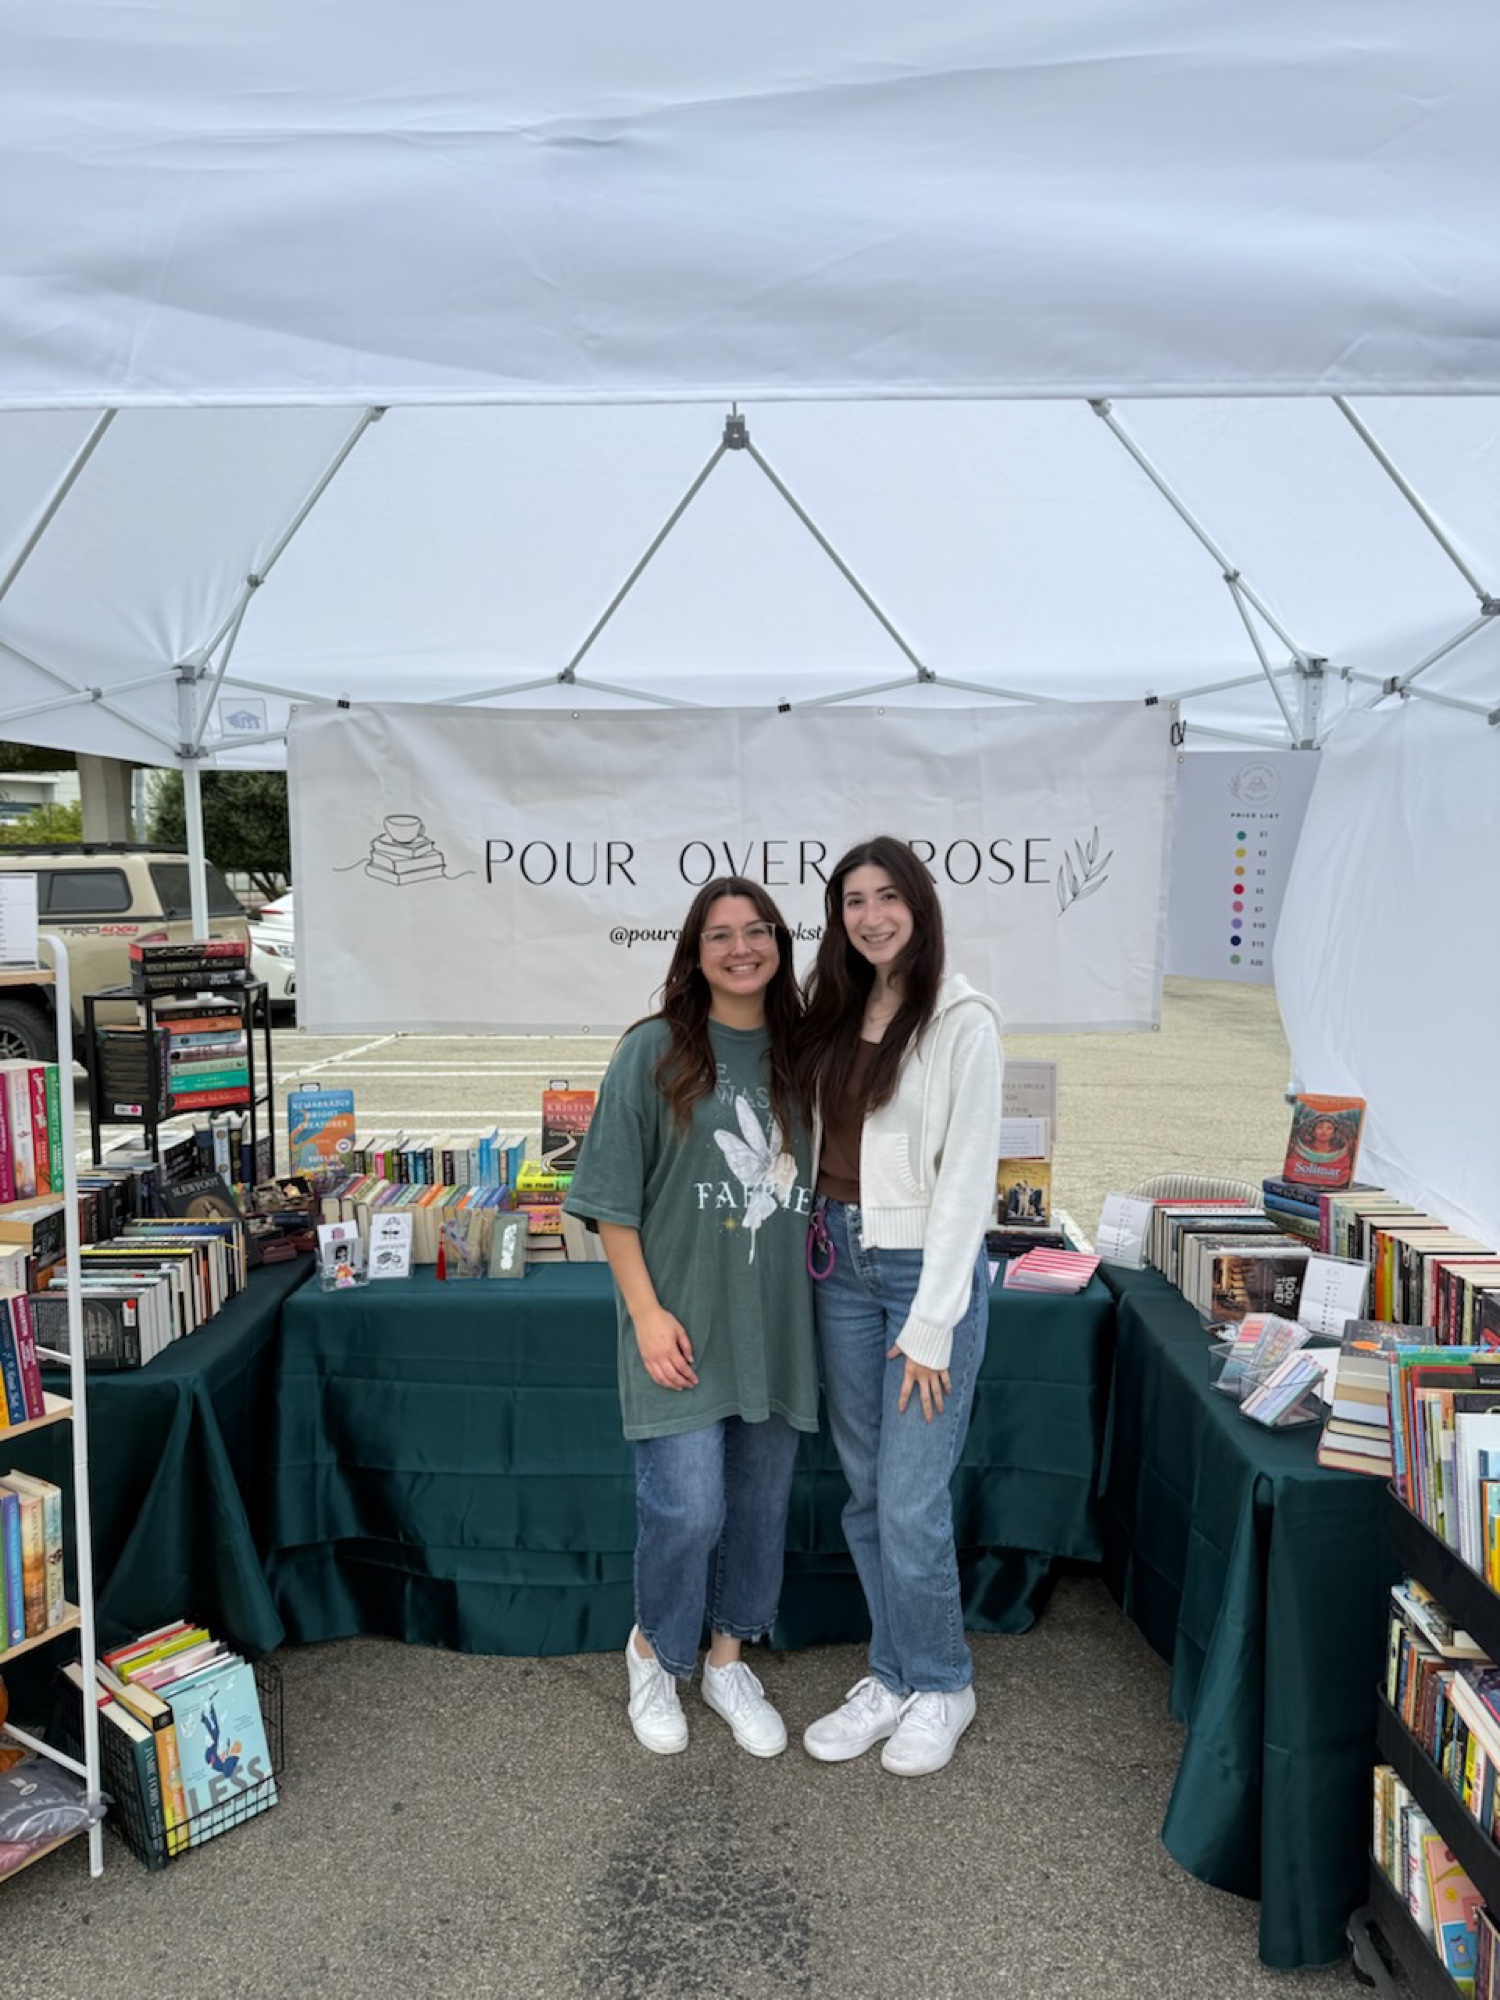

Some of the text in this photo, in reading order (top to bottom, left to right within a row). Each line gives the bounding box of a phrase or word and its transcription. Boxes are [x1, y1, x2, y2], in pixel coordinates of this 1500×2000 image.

[485, 837, 1051, 886] POUR OVER ROSE
[1293, 1159, 1342, 1177] Solimar
[187, 1755, 265, 1822] LESS
